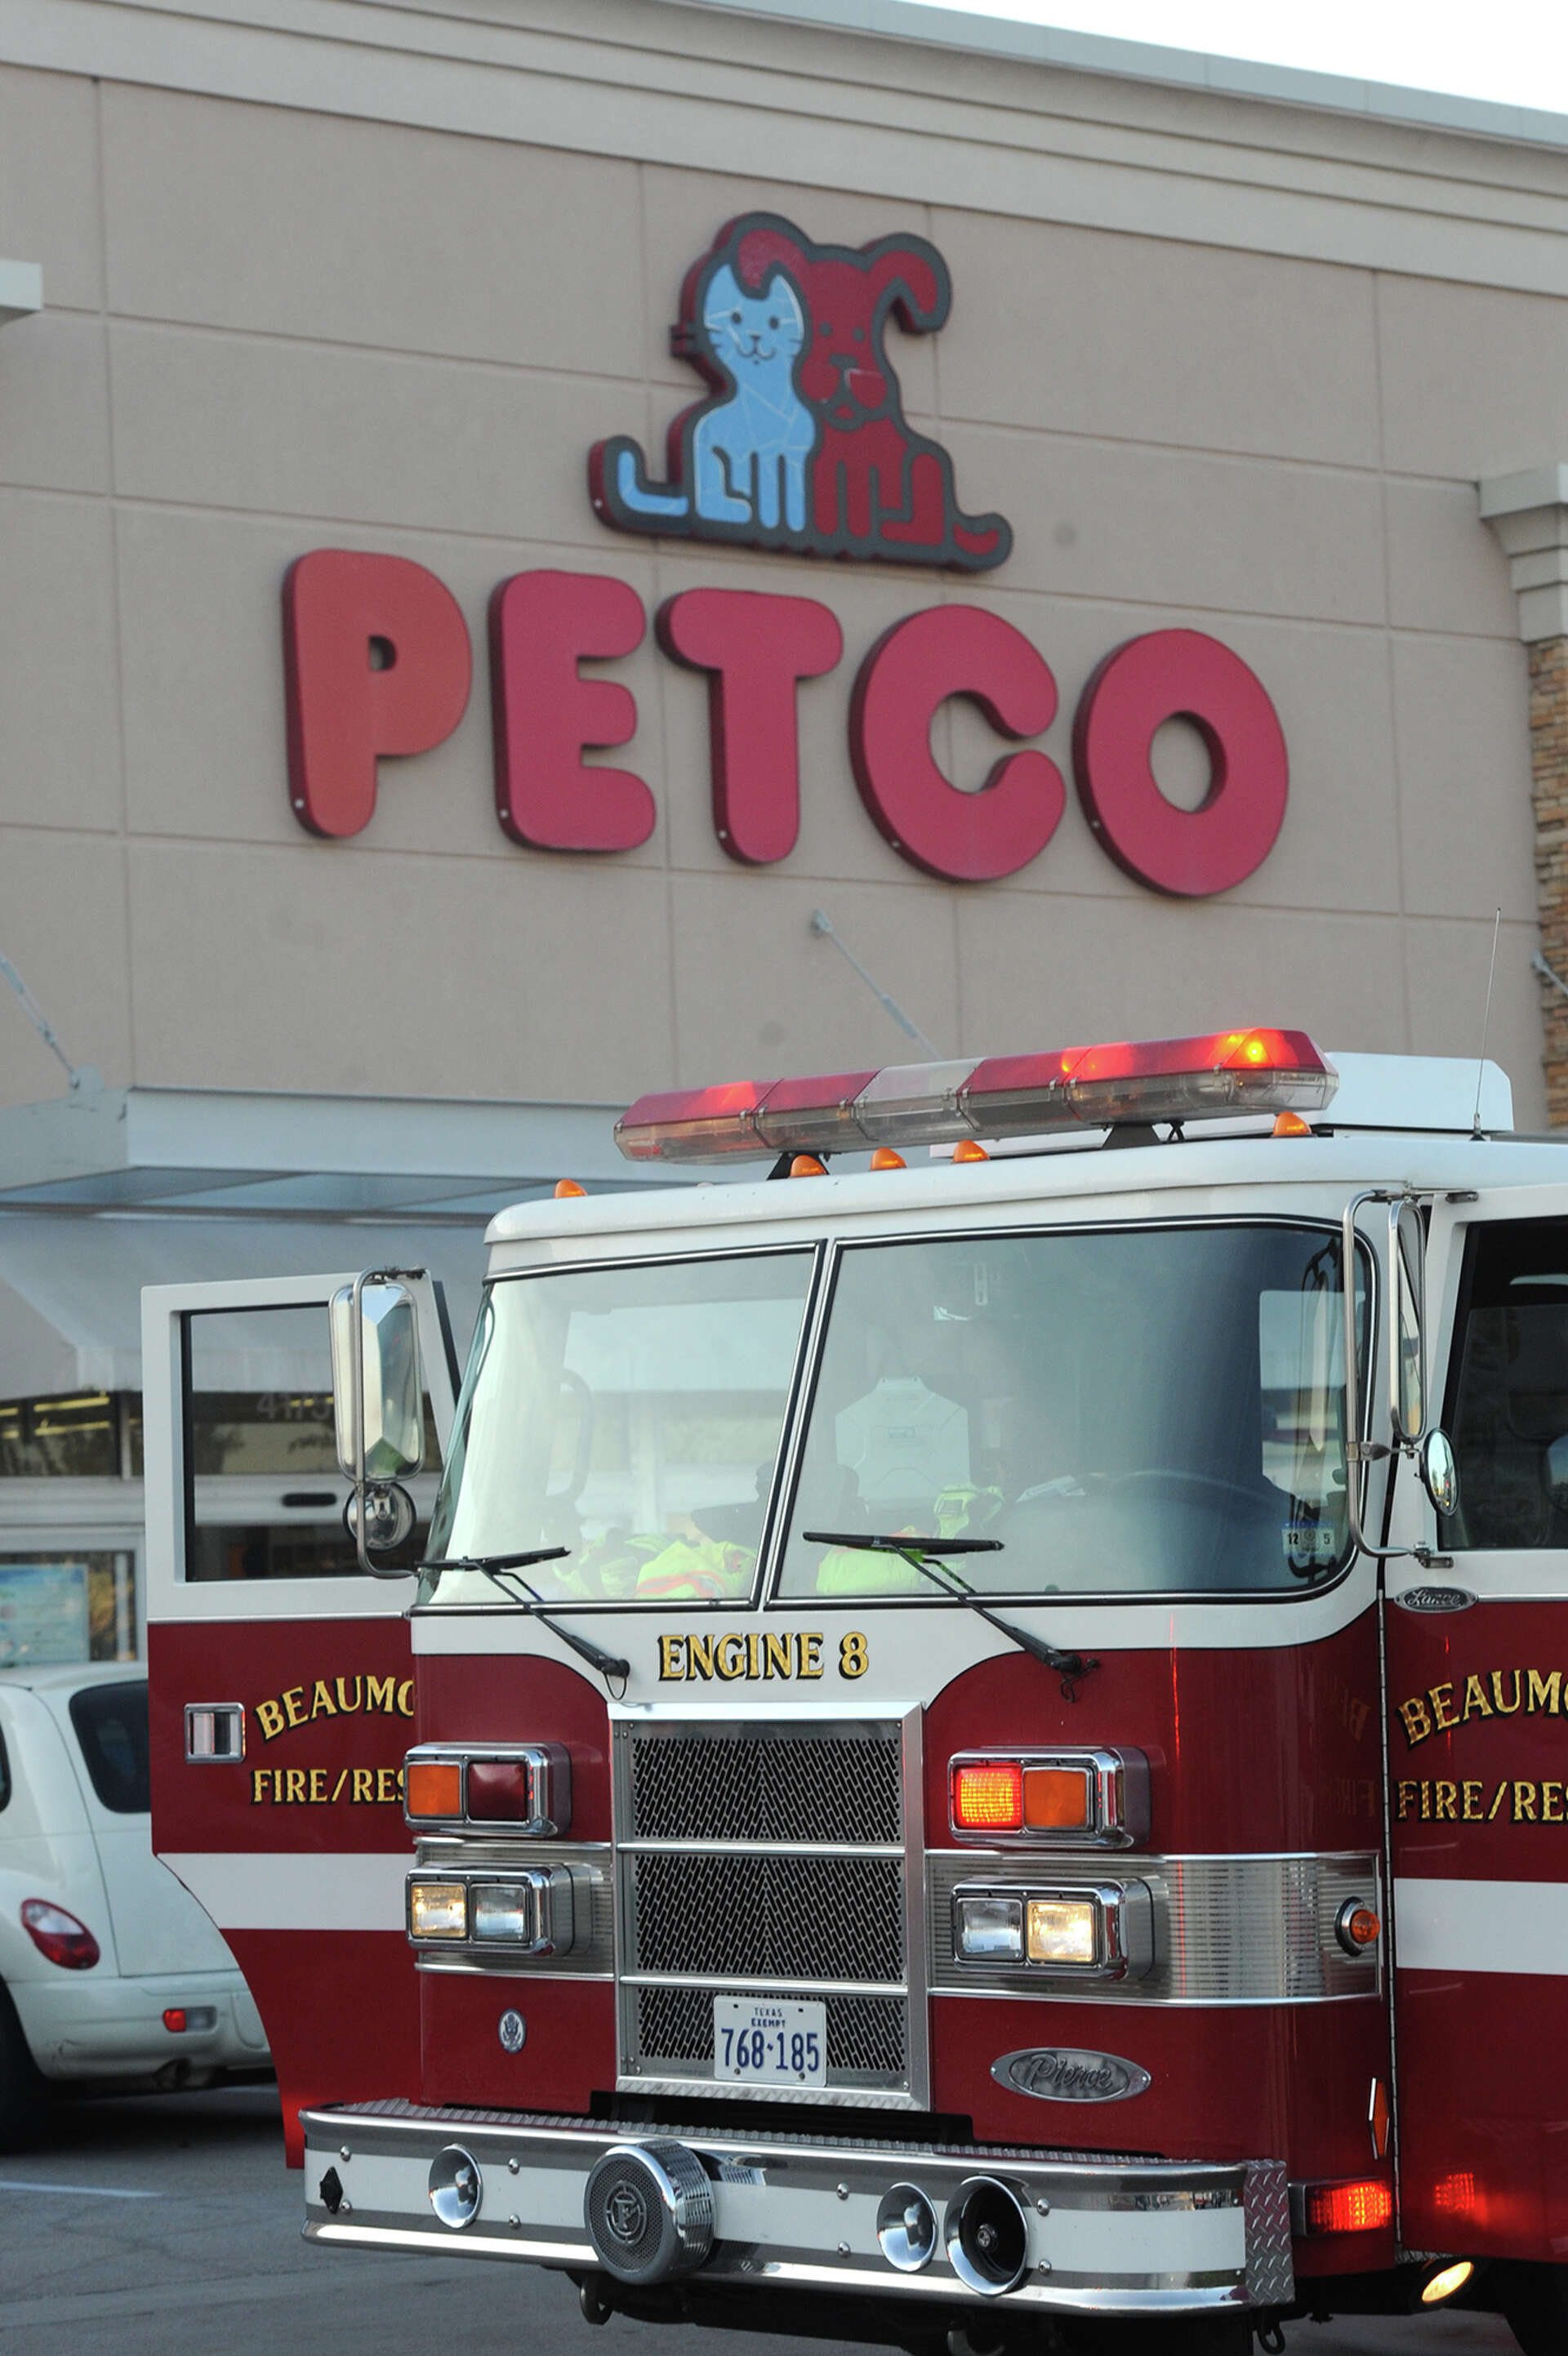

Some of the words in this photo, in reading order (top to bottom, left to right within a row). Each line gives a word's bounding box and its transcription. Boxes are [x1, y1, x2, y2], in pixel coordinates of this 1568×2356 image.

[282, 548, 1289, 897] PETCO
[1287, 1533, 1299, 1545] 12
[657, 1633, 825, 1681] ENGINE
[839, 1632, 869, 1680] 8
[1396, 1669, 1568, 1751] BEAUM
[1396, 1780, 1568, 1824] FIRE/RE
[751, 2018, 786, 2028] EXEMPT
[755, 2007, 782, 2017] TEXAS
[1024, 2053, 1113, 2091] Pierce
